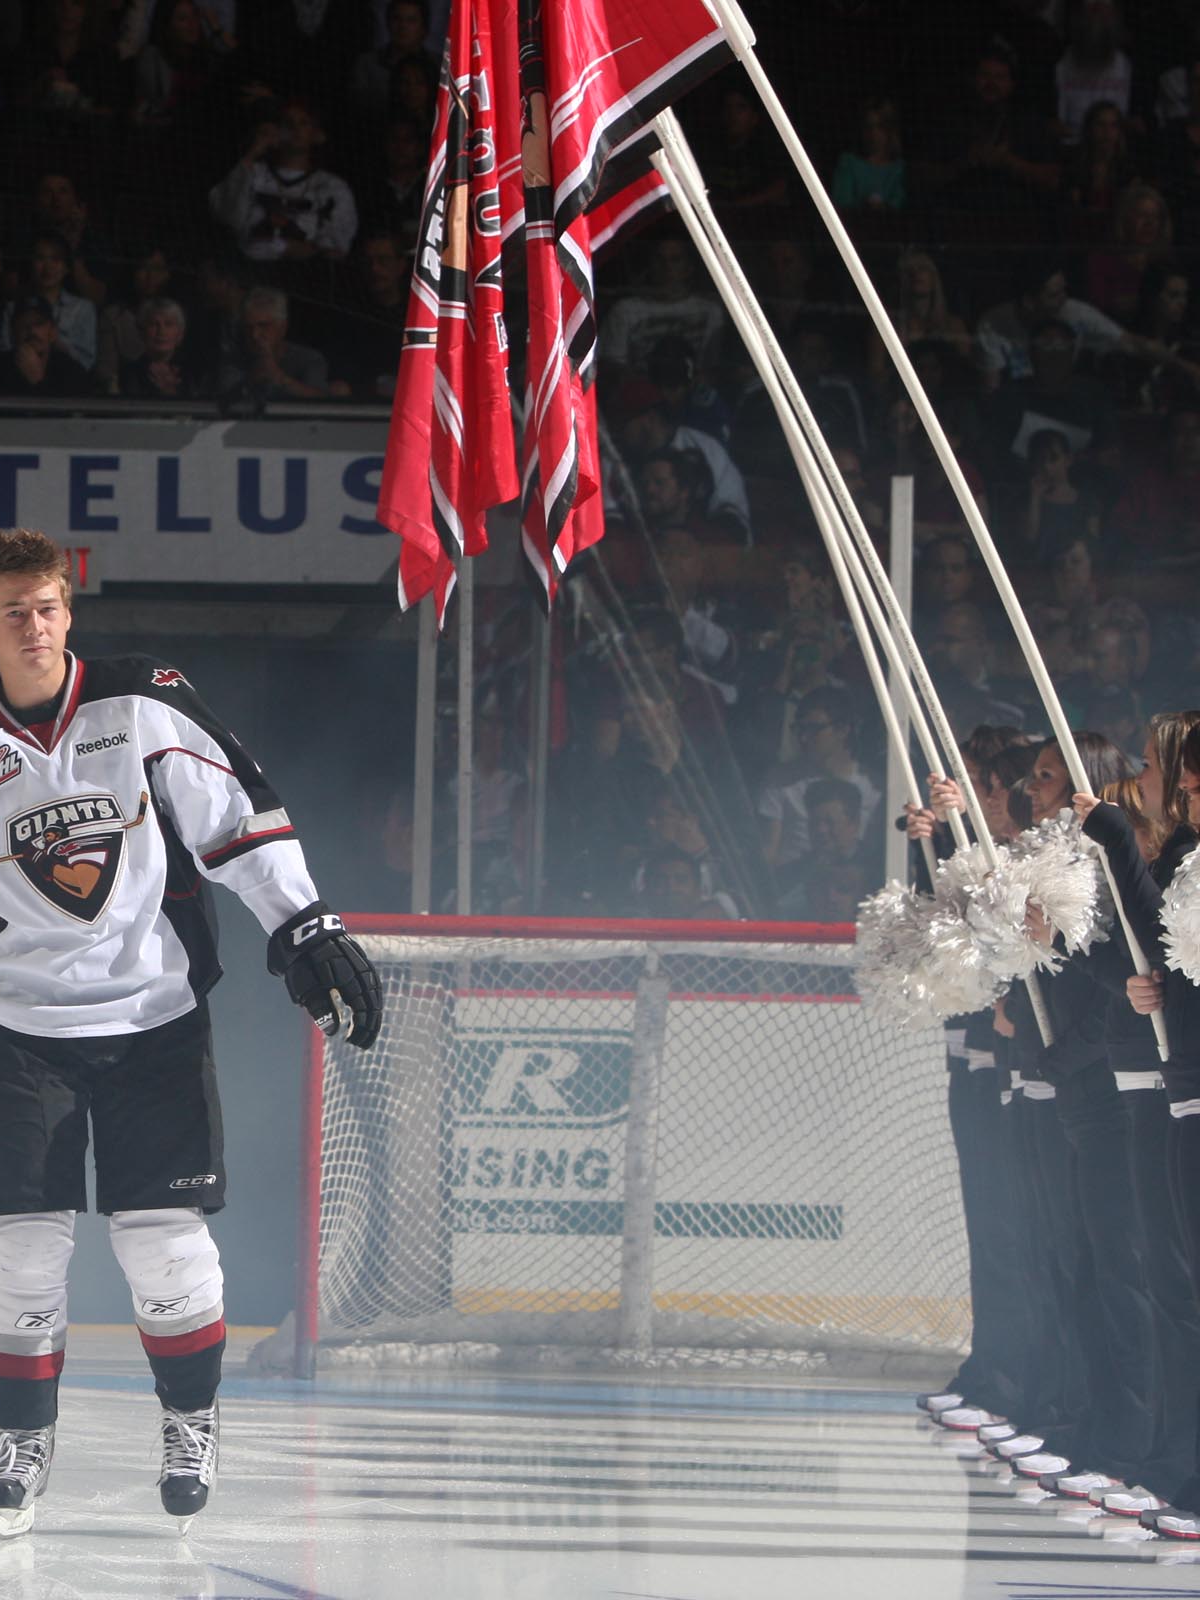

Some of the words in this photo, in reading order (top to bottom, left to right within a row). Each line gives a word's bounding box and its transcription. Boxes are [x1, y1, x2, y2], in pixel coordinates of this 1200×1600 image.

[75, 732, 129, 756] Reebok
[14, 800, 114, 841] GIANTS
[175, 1177, 214, 1186] CCM
